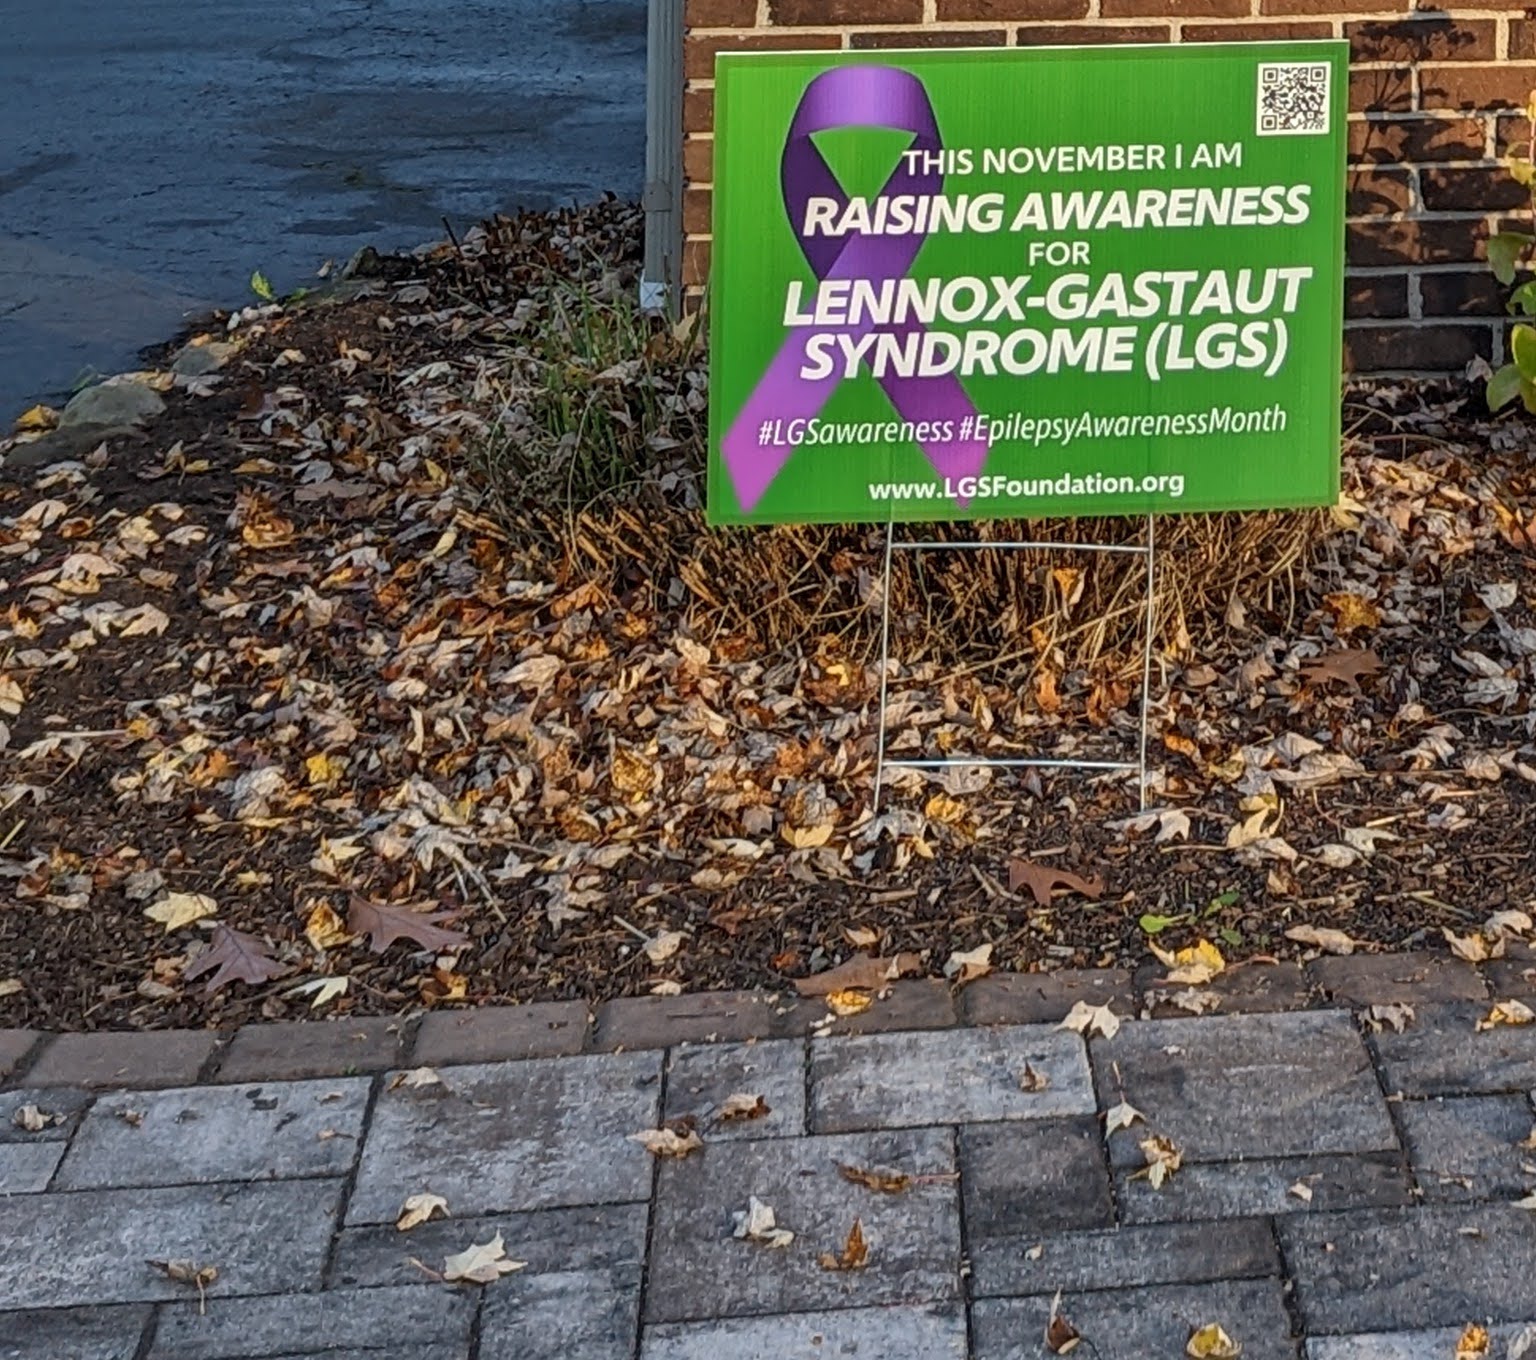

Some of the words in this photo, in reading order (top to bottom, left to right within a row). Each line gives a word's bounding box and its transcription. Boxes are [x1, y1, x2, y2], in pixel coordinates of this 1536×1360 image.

[903, 149, 973, 176] THIS
[983, 145, 1165, 175] NOVEMBER
[1175, 144, 1181, 169] I
[1192, 142, 1243, 168] AM
[803, 193, 1003, 236] RAISING
[1011, 185, 1311, 231] AWARENESS
[1029, 242, 1090, 266] FOR
[783, 268, 1312, 326] LENNOX-GASTAUT
[801, 327, 1137, 379] SYNDROME
[1145, 319, 1288, 380] (LGS)
[759, 420, 953, 446] #LGSawareness
[959, 405, 1286, 447] #EpilepsyAwarenessMonth
[869, 474, 1184, 500] www.LGSFoundation.org
